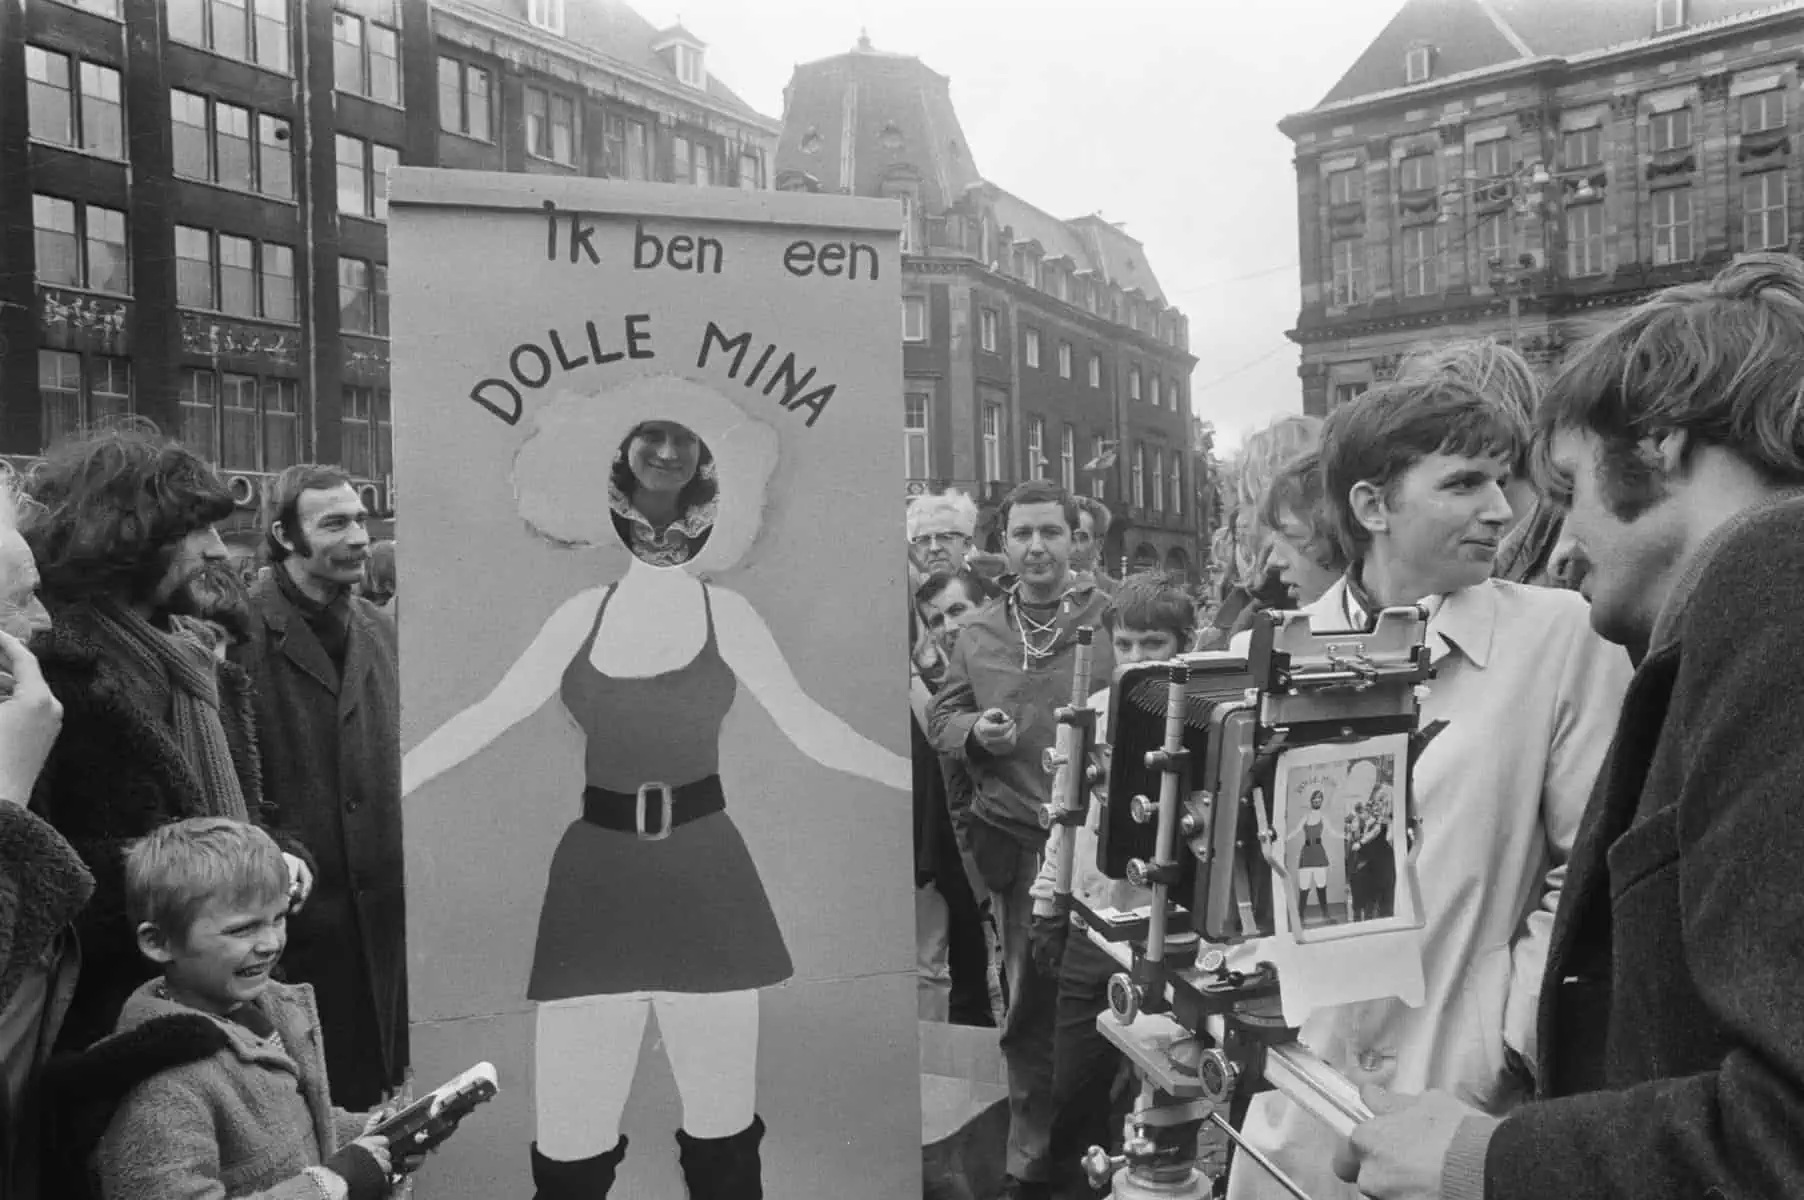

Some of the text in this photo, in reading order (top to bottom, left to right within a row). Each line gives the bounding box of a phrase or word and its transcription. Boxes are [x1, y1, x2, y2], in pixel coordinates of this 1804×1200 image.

[633, 219, 724, 274] ben
[783, 240, 880, 280] een
[470, 313, 837, 428] DOLLE MINA
